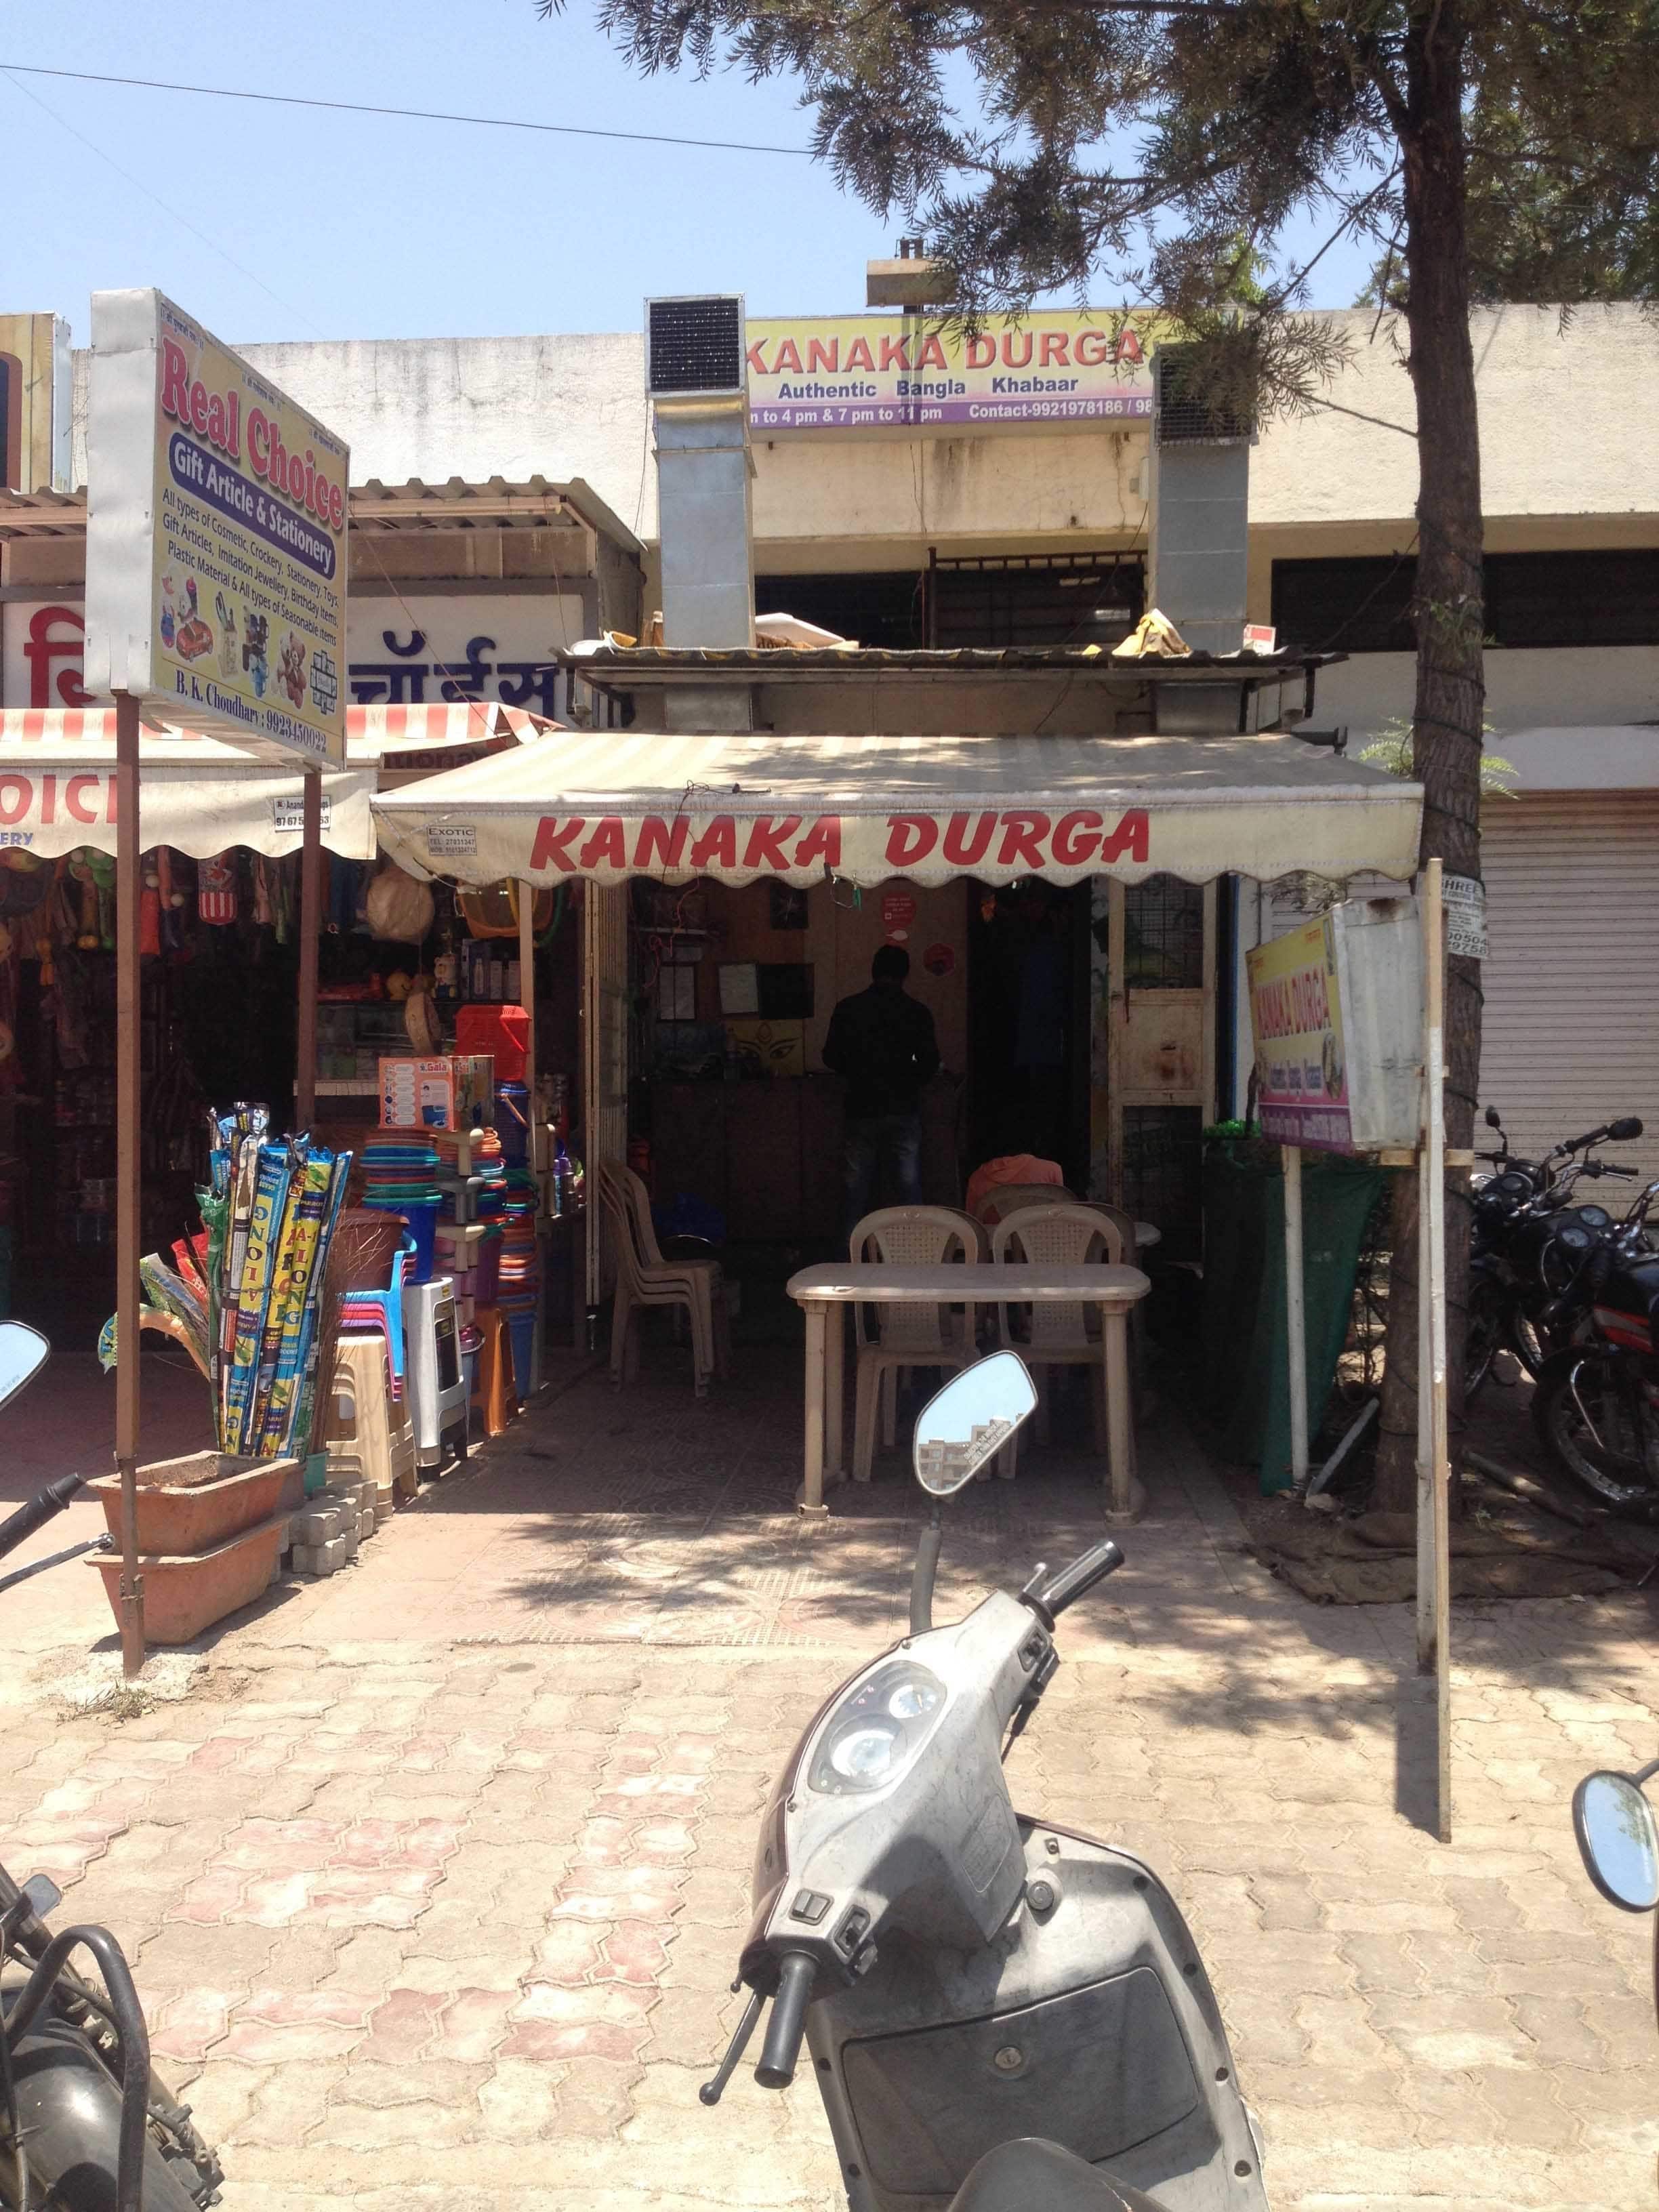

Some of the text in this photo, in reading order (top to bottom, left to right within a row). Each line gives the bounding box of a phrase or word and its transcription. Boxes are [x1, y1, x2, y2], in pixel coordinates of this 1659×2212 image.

[746, 329, 1145, 374] KANAKA DURGA
[763, 409, 777, 424] to
[781, 409, 792, 423] 4
[796, 411, 817, 426] pm
[822, 409, 833, 422] &
[838, 408, 847, 422] 7
[852, 410, 874, 425] pm
[878, 408, 893, 421] to
[898, 407, 914, 421] 11
[920, 407, 943, 423] pm
[778, 376, 1079, 398] Authentic Bangla Khabaar
[162, 338, 342, 530] Real Choice
[174, 442, 332, 574] Gift Article & Stationery
[163, 488, 175, 508] All
[177, 497, 199, 522] types
[202, 513, 211, 528] of
[211, 517, 249, 554] Cosmetic,
[250, 541, 283, 575] Crockery,
[287, 563, 322, 598] Stationery,
[163, 512, 180, 535] Gift
[181, 524, 214, 557] Articles,
[218, 544, 253, 577] Imitation
[254, 567, 289, 601] Jewellery,
[291, 588, 319, 619] Birthday
[168, 539, 195, 569] Plastic
[197, 556, 230, 587] Material
[232, 576, 238, 591] &
[239, 581, 249, 598] All
[251, 588, 271, 609] types
[272, 601, 280, 614] of
[281, 603, 319, 636] Seasonable
[176, 670, 188, 695] B.
[192, 676, 203, 702] K.
[206, 683, 260, 726] Choudhary
[529, 808, 1151, 872] KANAKA DURGA
[428, 1063, 448, 1071] Gala
